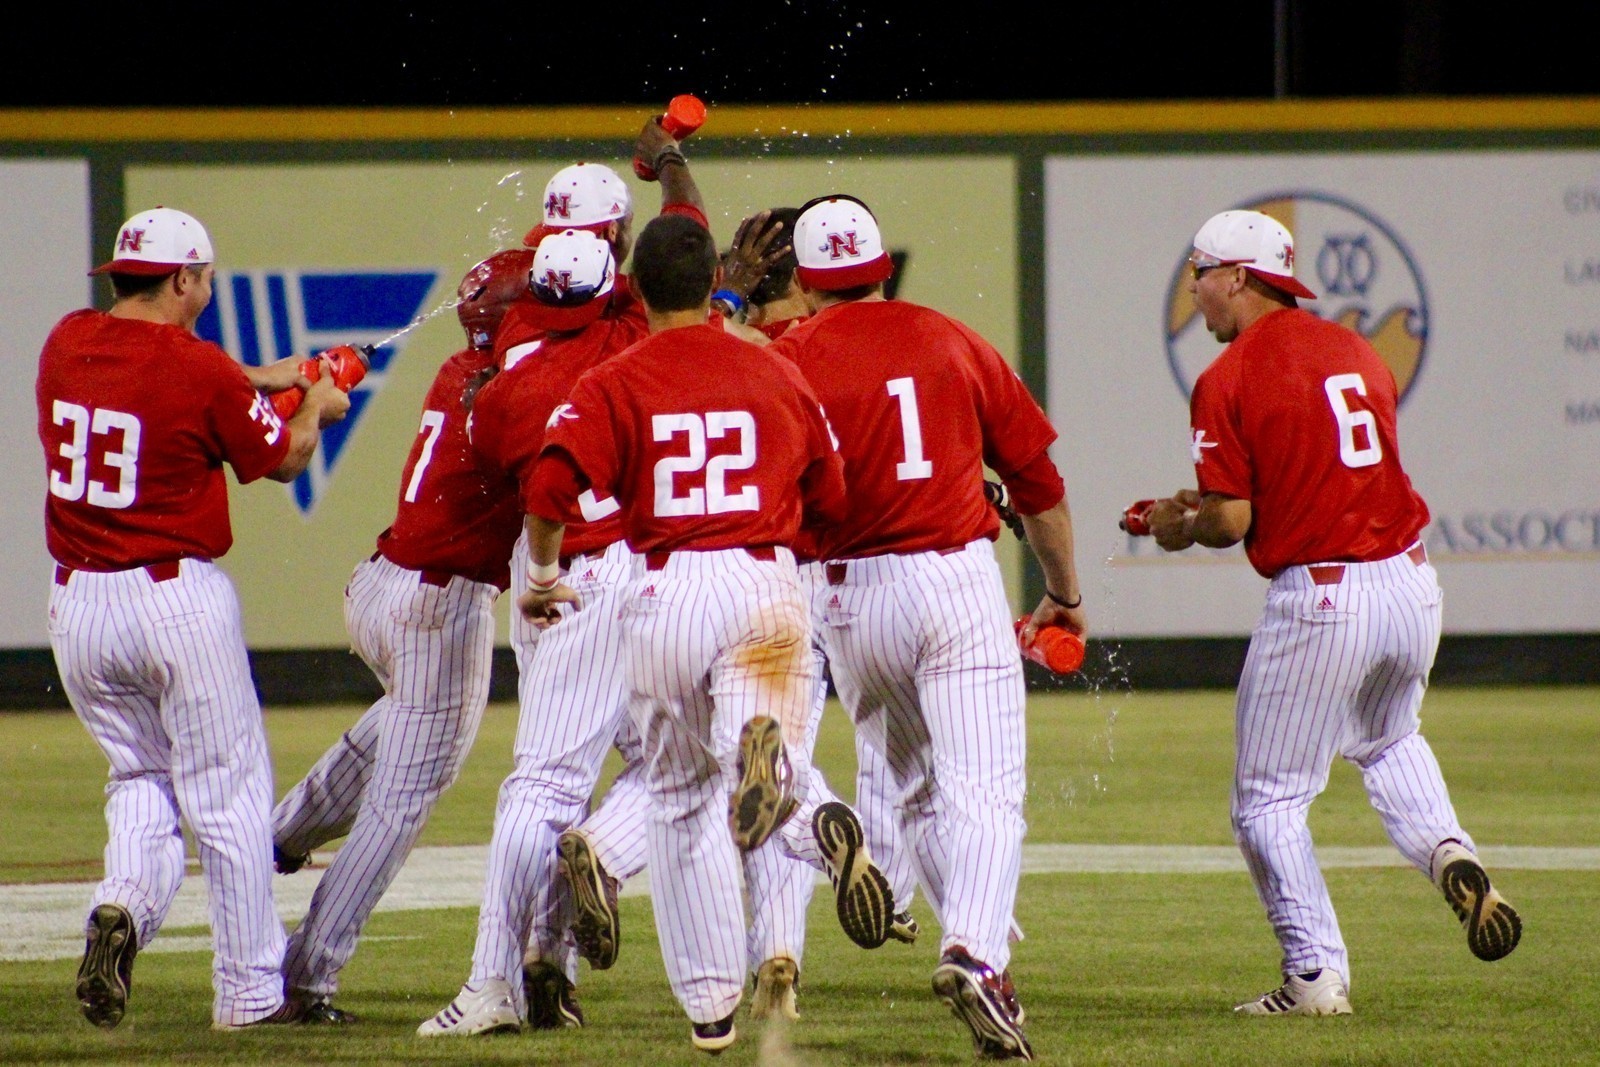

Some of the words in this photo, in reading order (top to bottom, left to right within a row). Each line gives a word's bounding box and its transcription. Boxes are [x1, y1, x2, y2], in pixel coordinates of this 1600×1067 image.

[119, 228, 145, 253] N
[547, 191, 571, 219] N
[827, 230, 860, 260] N
[50, 400, 141, 509] 33
[404, 410, 446, 503] 7
[652, 411, 760, 517] 22
[886, 377, 932, 481] 1
[1325, 373, 1382, 468] 6
